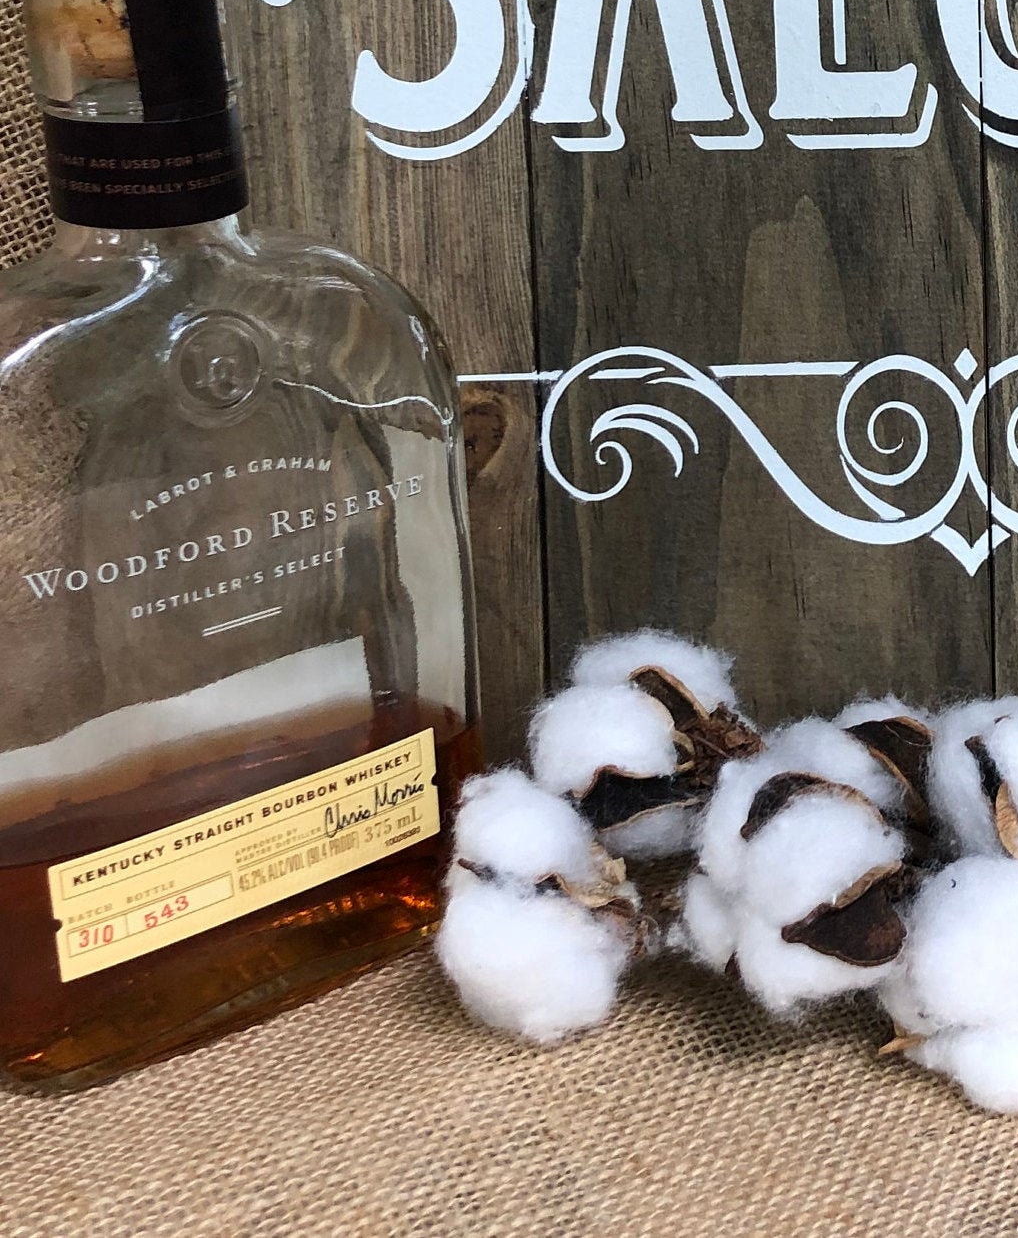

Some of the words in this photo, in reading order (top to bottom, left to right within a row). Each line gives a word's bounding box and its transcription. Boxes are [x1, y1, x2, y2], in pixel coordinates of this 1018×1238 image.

[90, 158, 117, 170] ARE
[121, 158, 161, 170] USED
[167, 155, 193, 169] FOR
[104, 183, 183, 196] SPECIALLY
[130, 471, 214, 522] LABROT
[223, 464, 238, 480] &
[247, 456, 333, 474] GRAHAM
[23, 526, 253, 600] WOODFORD
[269, 476, 422, 539] RESERVE
[131, 570, 265, 619] DISTILLER'S
[273, 546, 347, 579] SELECT
[373, 770, 426, 816] Morris
[72, 845, 166, 887] KENTUCKY
[174, 812, 255, 851] STRAIGHT
[261, 781, 339, 819] BOURBON
[344, 750, 413, 788] WHISKEY
[363, 817, 393, 844] 375
[396, 805, 424, 830] mL
[67, 903, 114, 925] BATCH
[126, 879, 177, 905] BOTTLE
[78, 923, 115, 949] 310
[143, 894, 190, 930] 543
